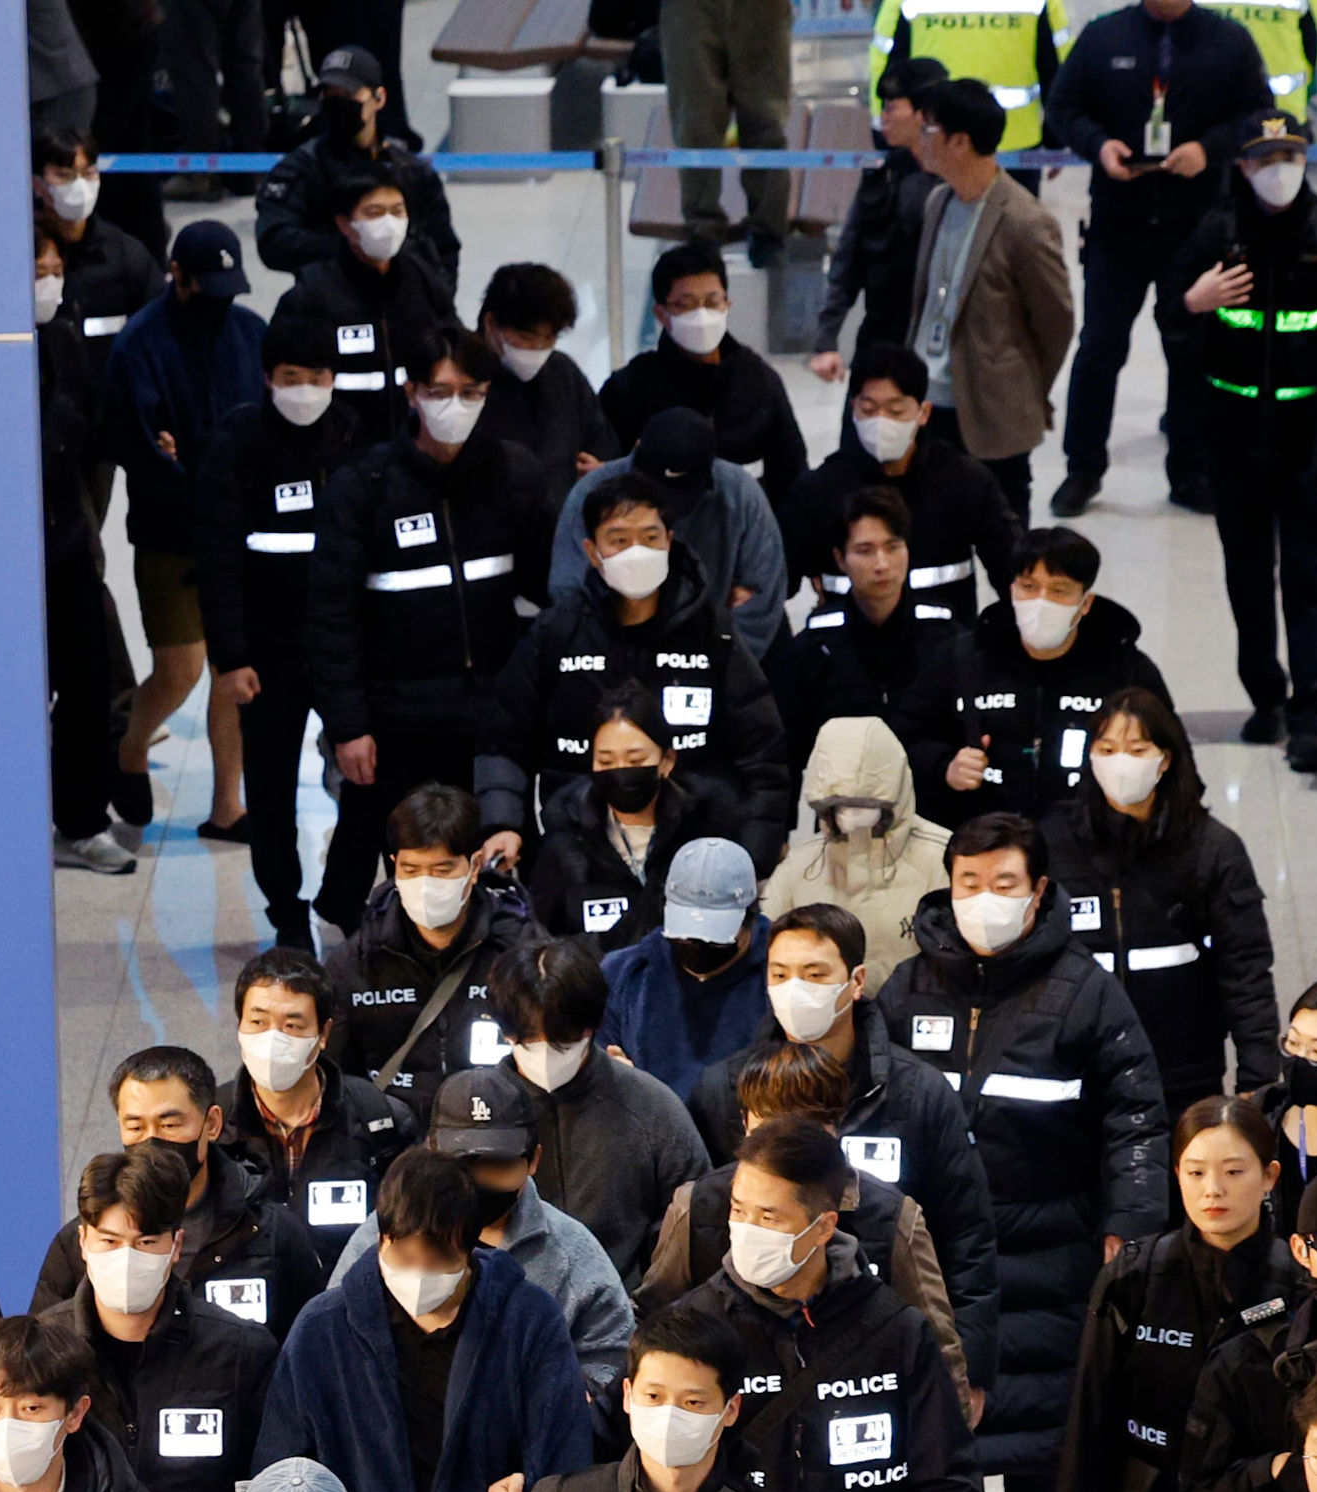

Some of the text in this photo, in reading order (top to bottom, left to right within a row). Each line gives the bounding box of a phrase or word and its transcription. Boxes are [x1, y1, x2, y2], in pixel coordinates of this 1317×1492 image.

[924, 14, 1022, 30] POLICE
[351, 988, 417, 1007] POLICE
[471, 1096, 492, 1121] LA
[738, 1375, 782, 1394] ICE
[817, 1373, 898, 1400] POLICE
